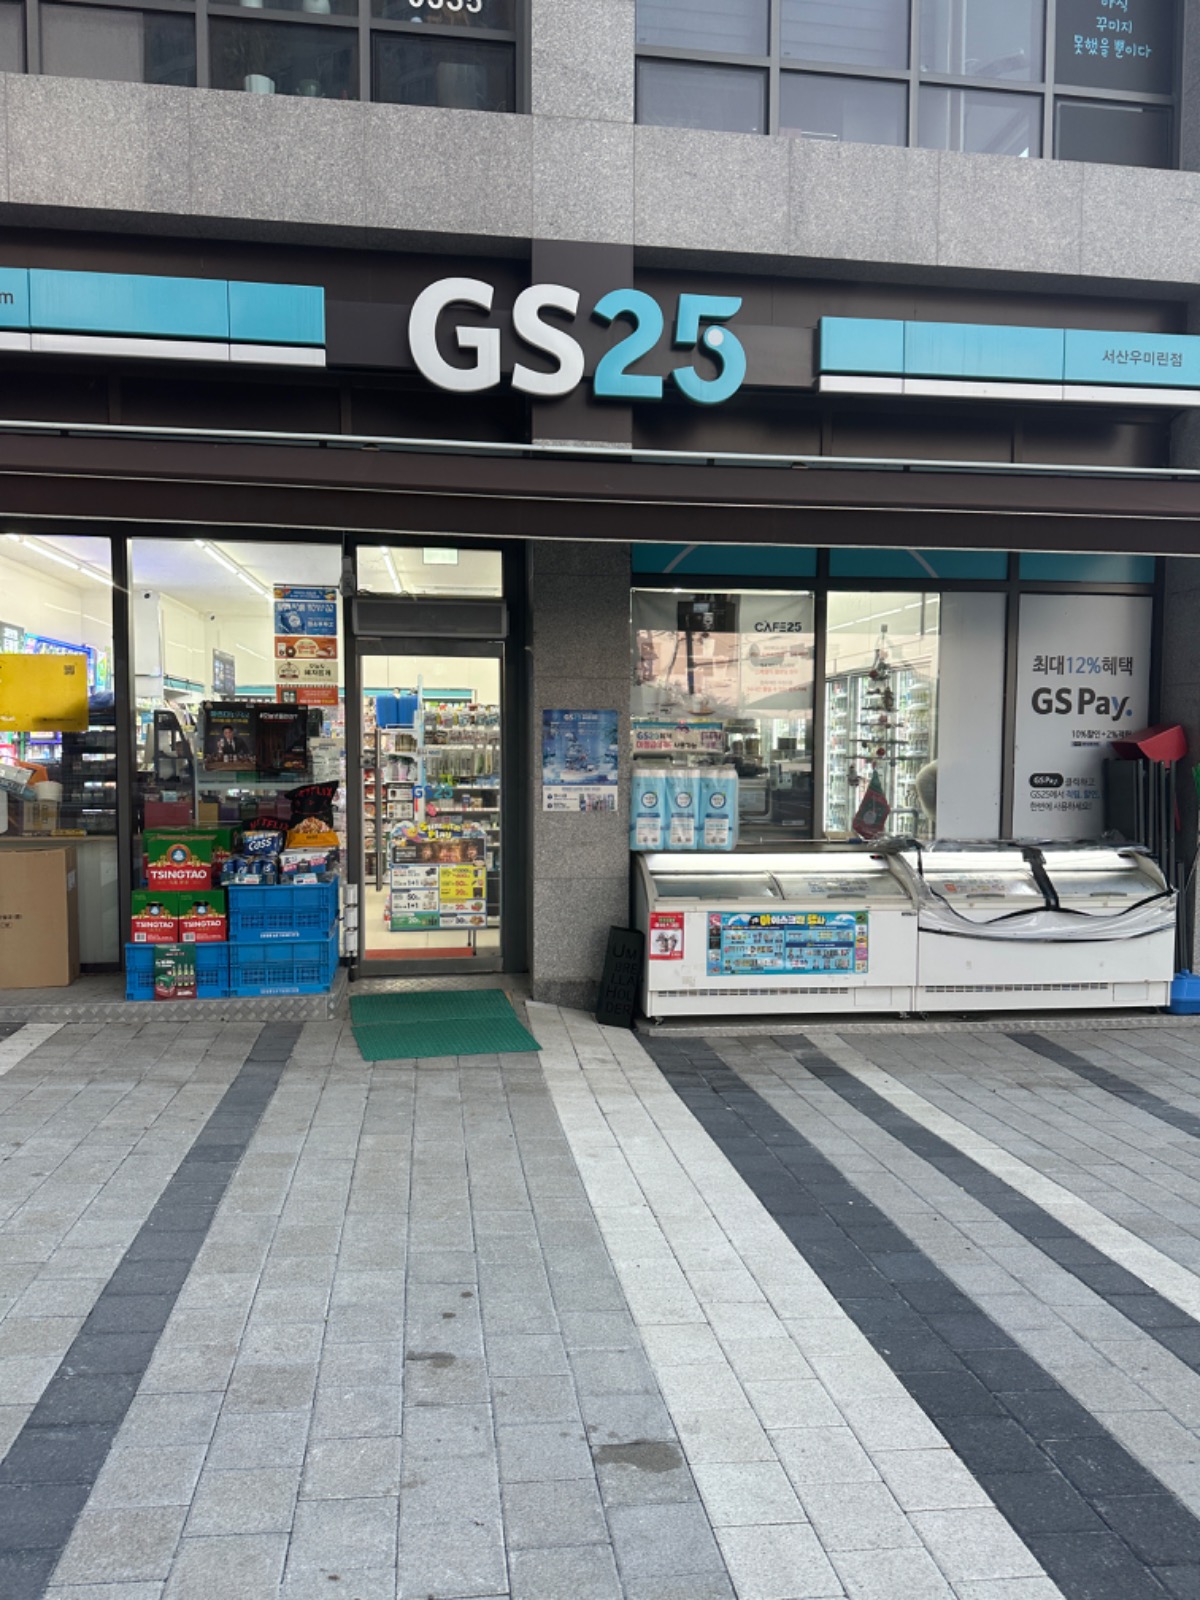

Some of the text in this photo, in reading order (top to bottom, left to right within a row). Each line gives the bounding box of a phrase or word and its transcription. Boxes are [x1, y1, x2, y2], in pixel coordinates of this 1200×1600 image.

[1096, 16, 1132, 34] 꾸미지
[1074, 34, 1152, 58] 못했을 뿐이다
[408, 277, 746, 404] GS25
[1102, 349, 1183, 367] 서산우미린점
[754, 621, 802, 633] CAFE25
[1032, 655, 1134, 677] 최대12%혜택
[1031, 687, 1073, 715] GS
[411, 785, 454, 799] GS25
[248, 837, 272, 852] Cass
[150, 869, 208, 880] TSINGTAO
[135, 921, 174, 929] TSINGTAO
[183, 920, 222, 929] TSINGTAO
